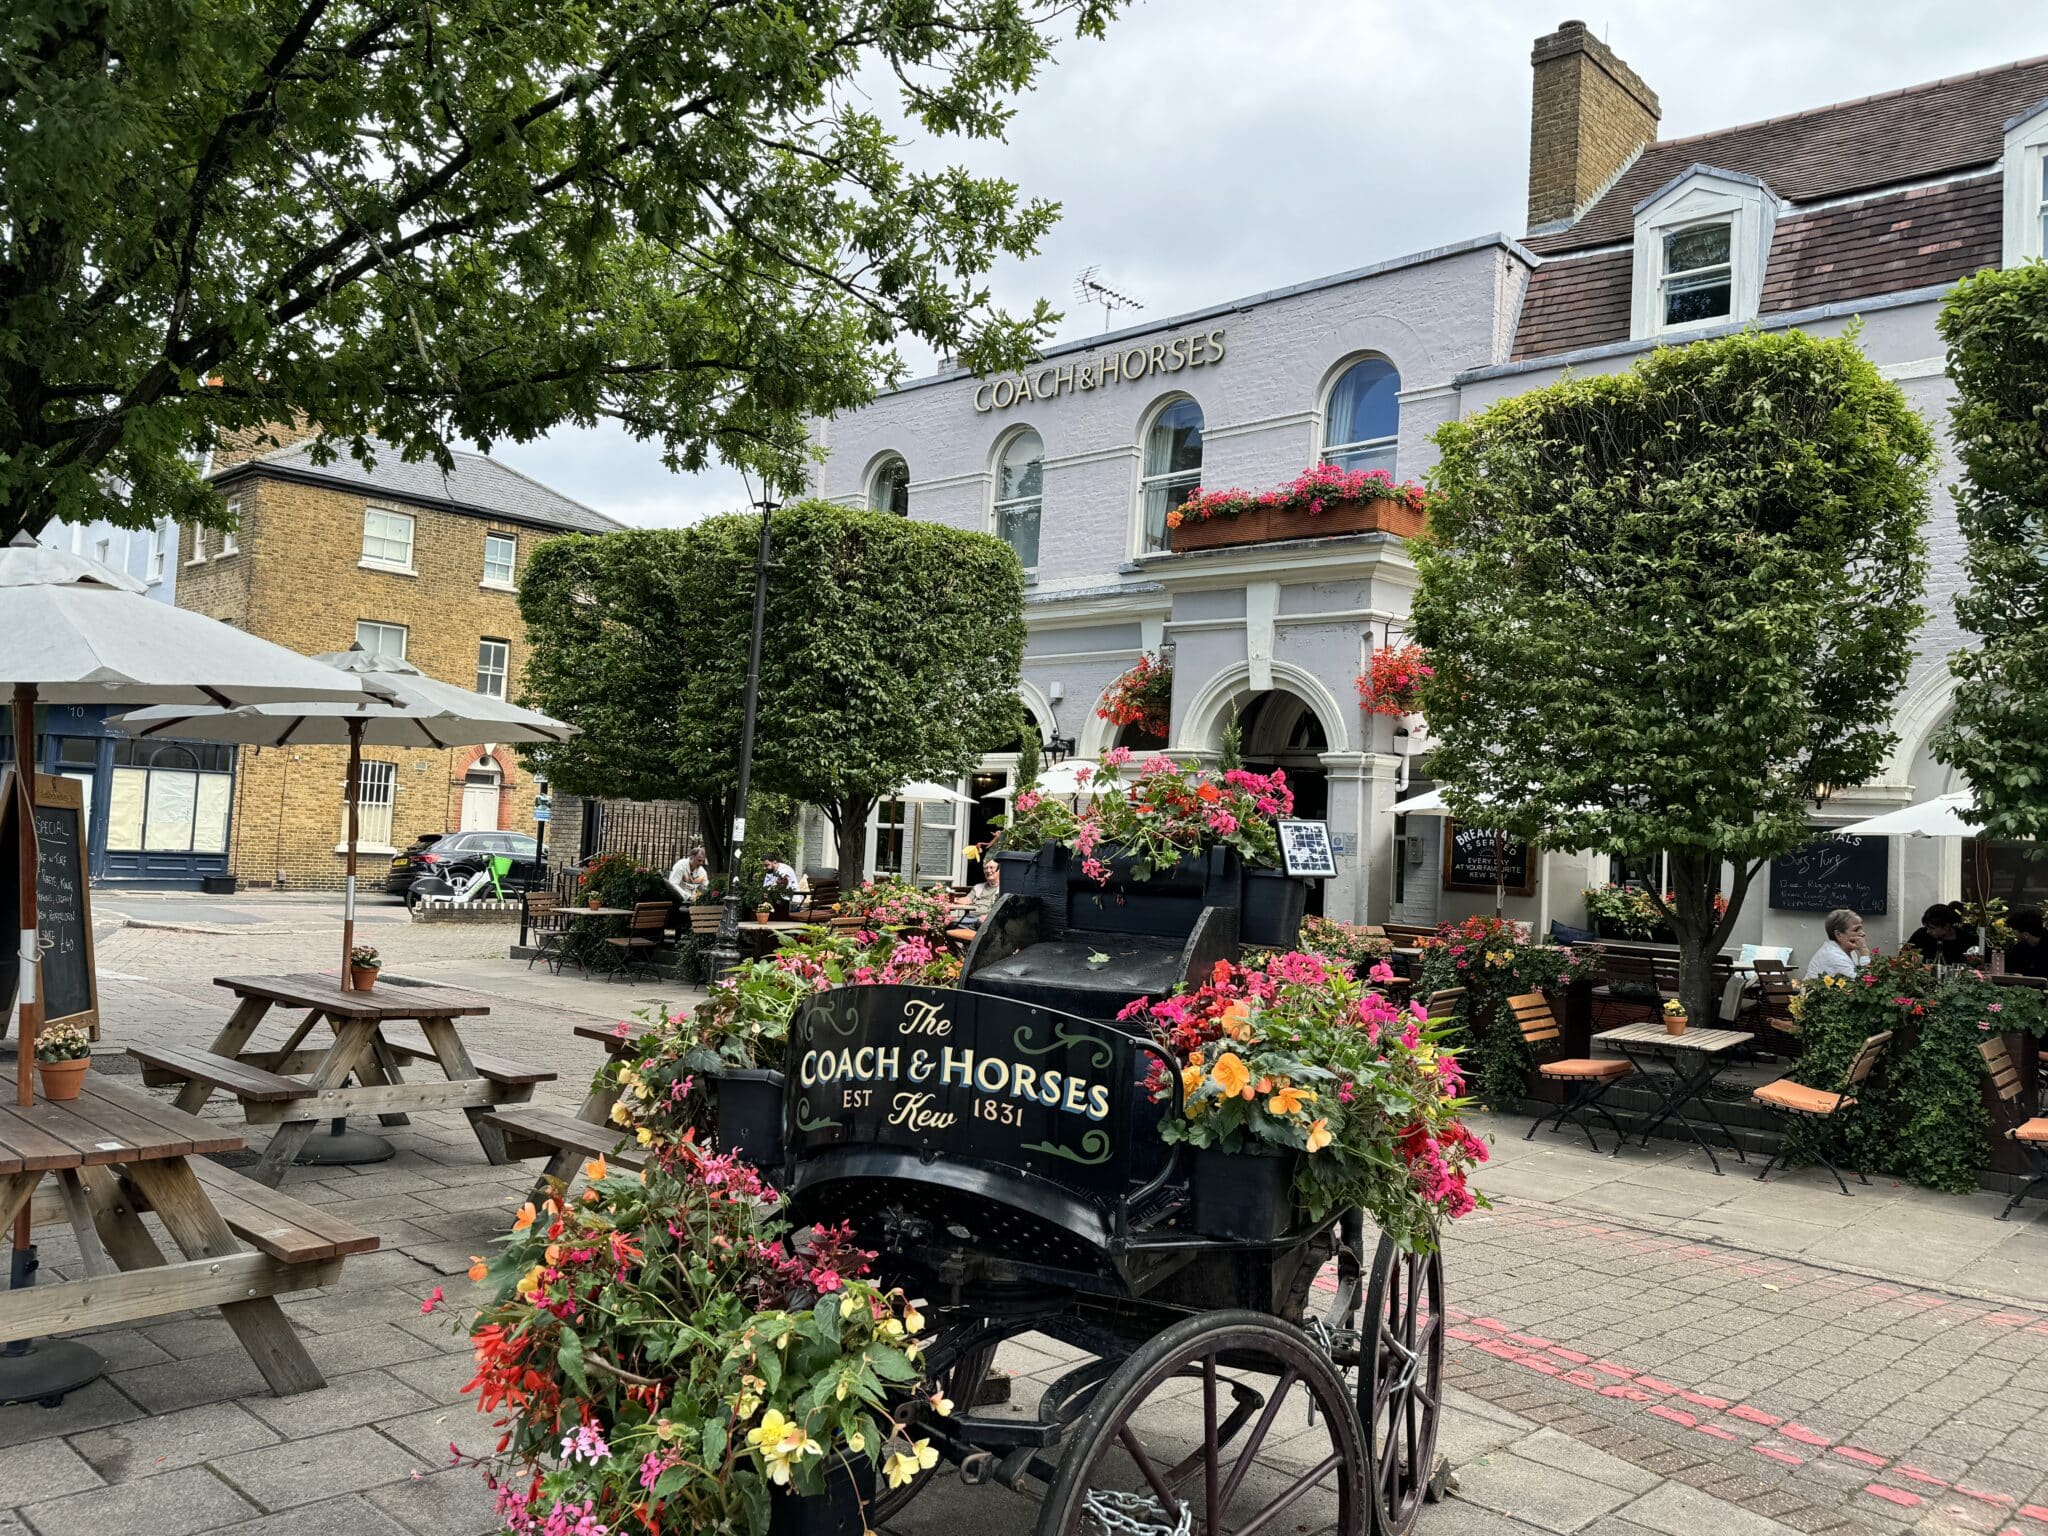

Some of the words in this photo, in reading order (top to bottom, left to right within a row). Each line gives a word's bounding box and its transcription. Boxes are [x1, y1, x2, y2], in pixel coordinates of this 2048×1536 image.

[974, 364, 1076, 413] COACH
[1080, 366, 1095, 390] &
[1100, 329, 1226, 387] HORSES
[1463, 844, 1473, 853] IS
[1476, 839, 1517, 856] SERED
[1468, 857, 1492, 865] EVERY
[1469, 871, 1487, 879] KEW
[899, 1000, 953, 1037] The
[801, 1046, 900, 1089] COACH
[908, 1049, 937, 1083] &
[939, 1046, 1110, 1122] HORSES
[843, 1089, 873, 1109] EST
[888, 1092, 957, 1132] Kew
[974, 1098, 1023, 1128] 1831
